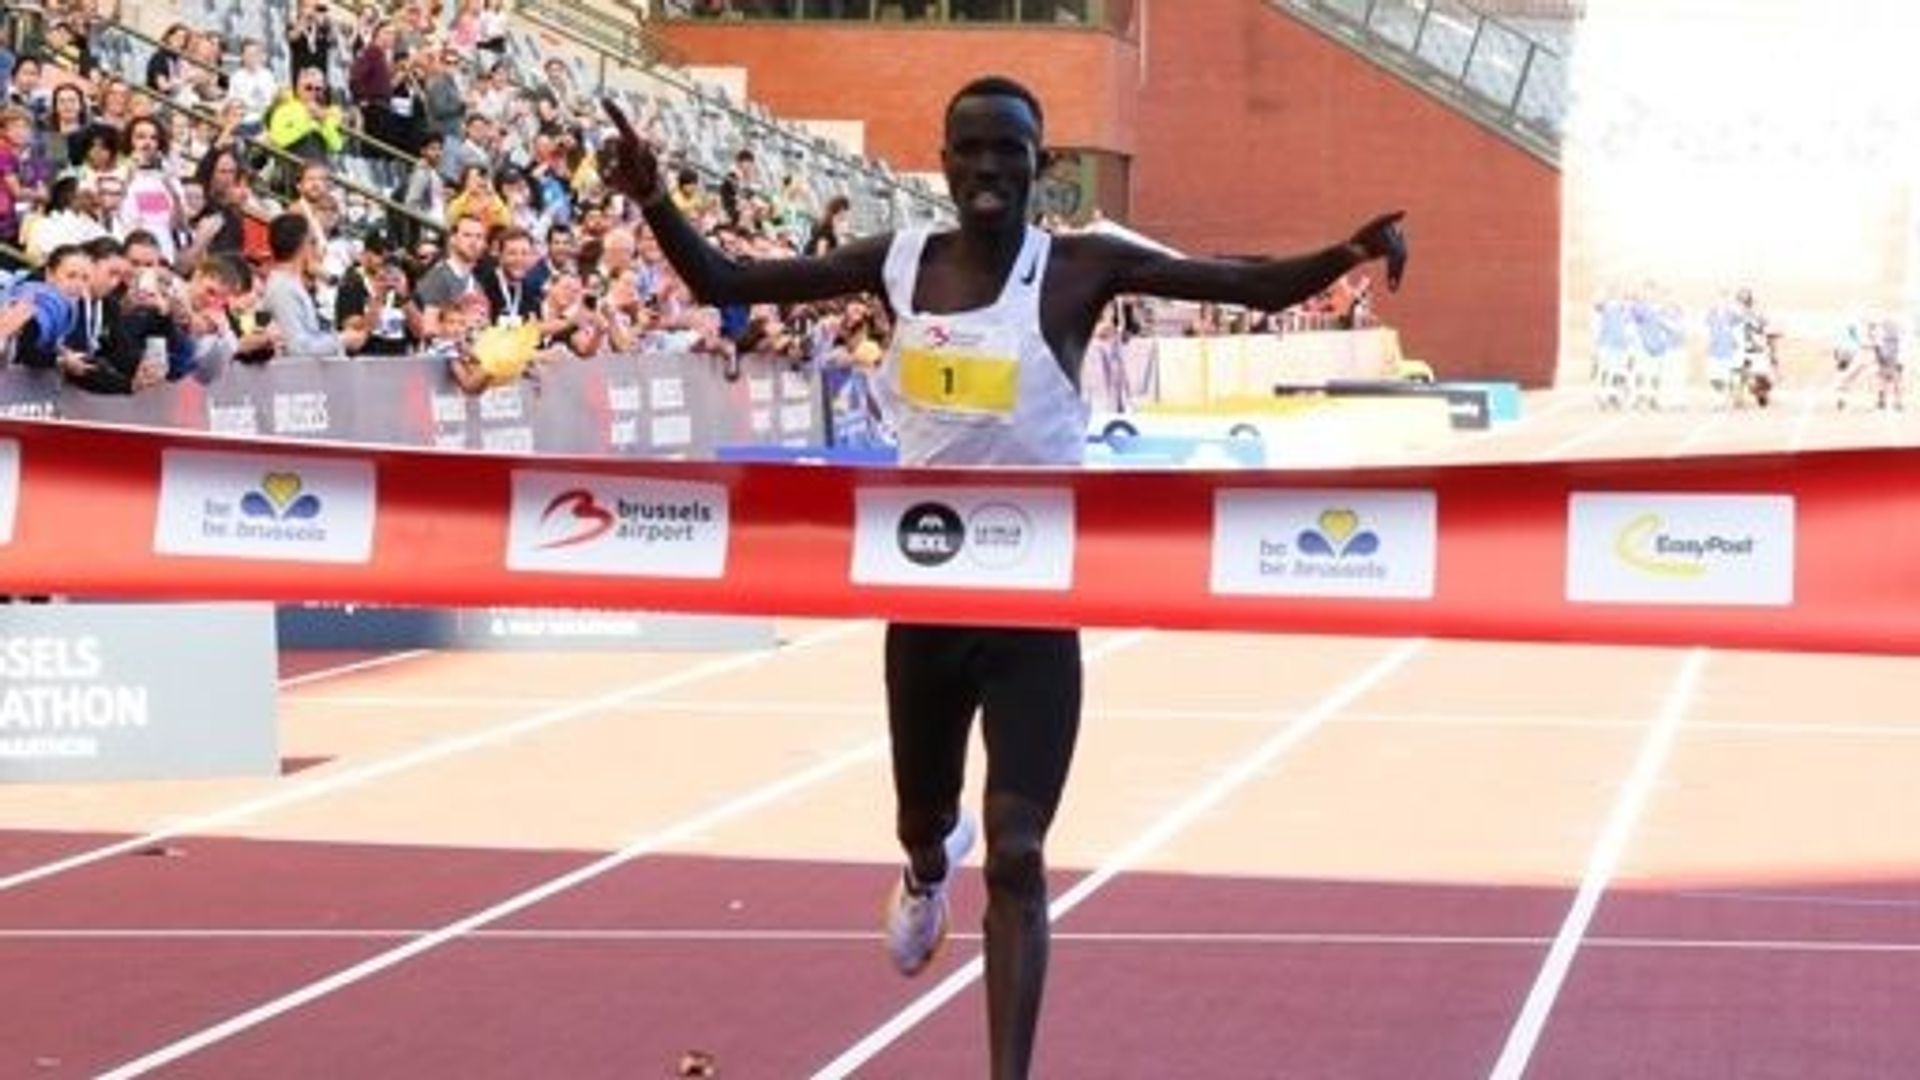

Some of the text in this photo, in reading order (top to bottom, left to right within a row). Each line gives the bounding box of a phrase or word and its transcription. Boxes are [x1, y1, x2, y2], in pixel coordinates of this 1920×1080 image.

[940, 367, 954, 396] 1
[618, 499, 711, 522] brussels
[616, 523, 694, 546] airport
[1657, 534, 1753, 559] EasyPost
